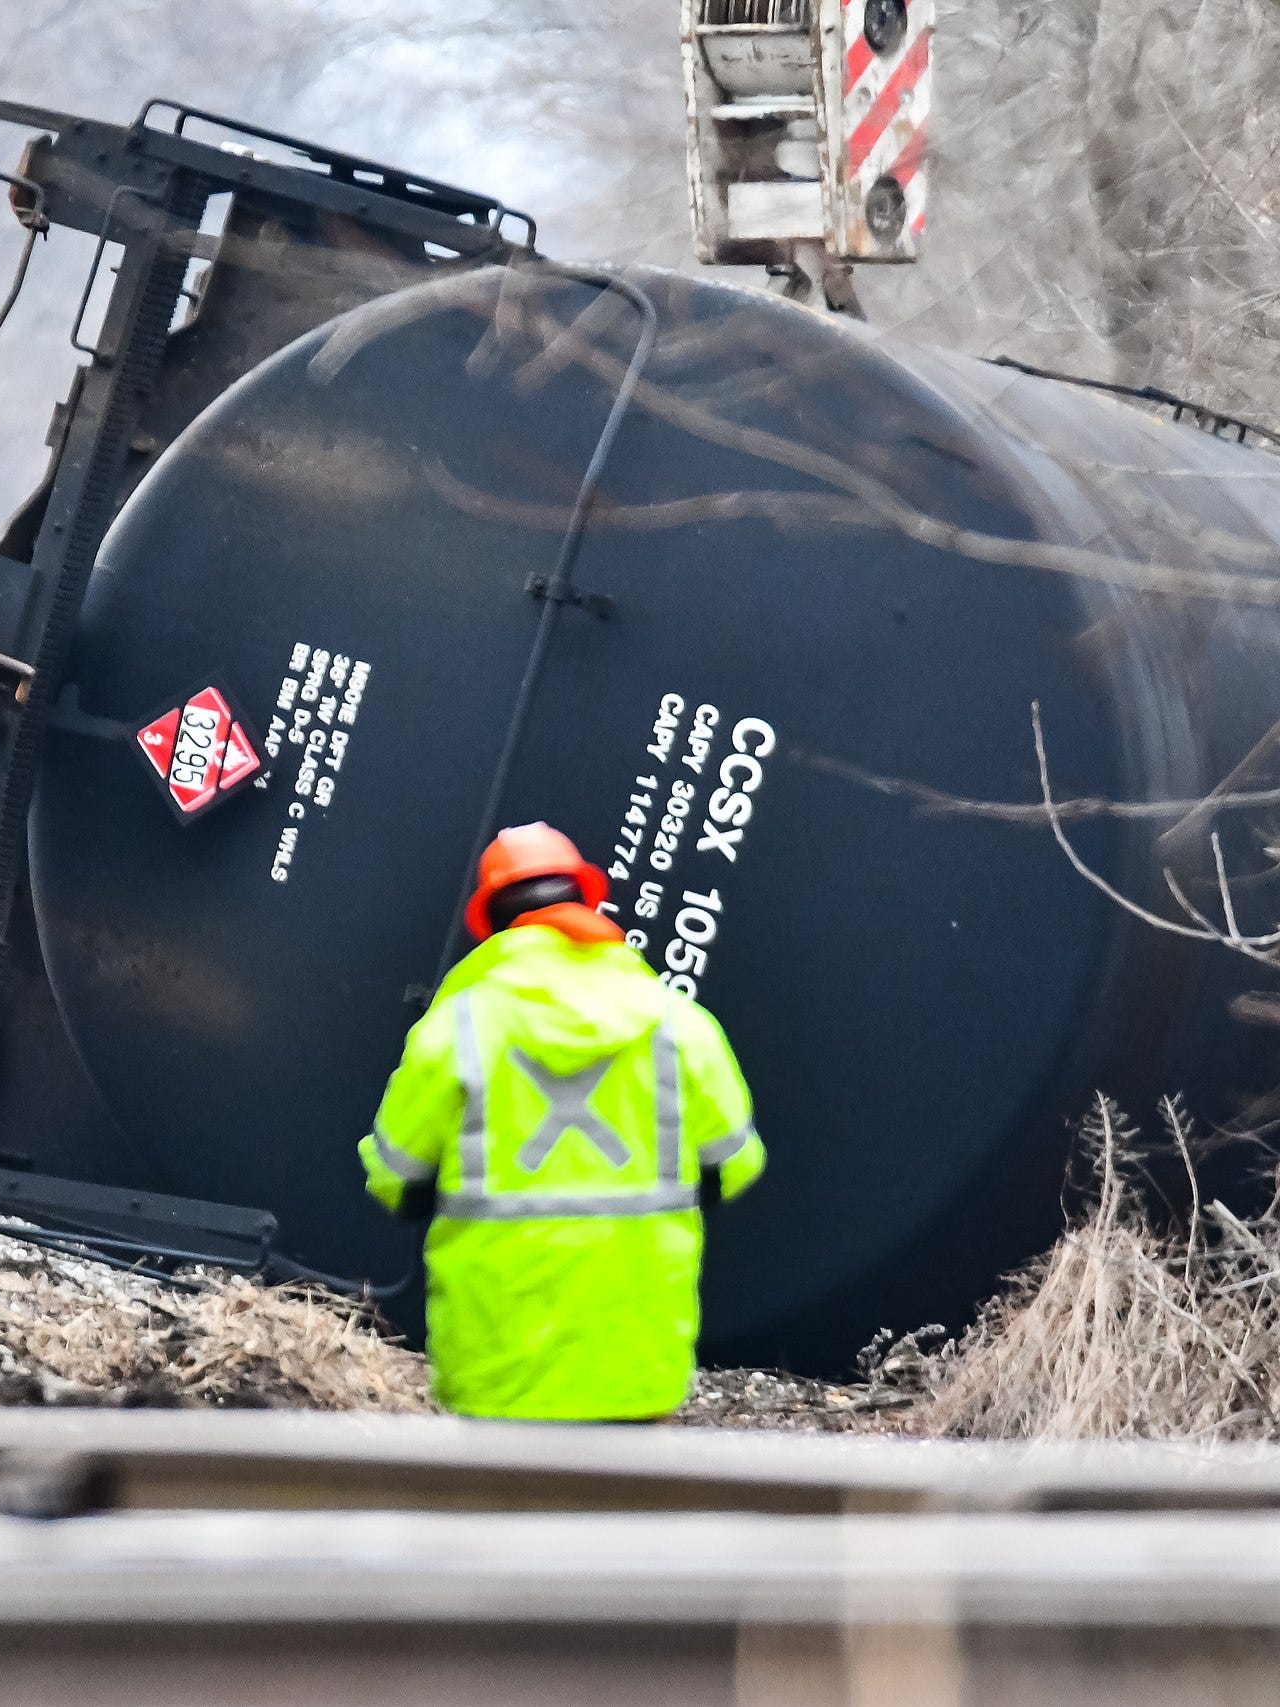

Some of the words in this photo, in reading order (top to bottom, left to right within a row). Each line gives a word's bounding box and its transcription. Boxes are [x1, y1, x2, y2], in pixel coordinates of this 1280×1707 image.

[289, 642, 311, 672] BR
[301, 648, 330, 701] SPRG
[276, 677, 300, 710] BM
[143, 730, 162, 746] 3
[173, 712, 216, 786] 3295
[325, 729, 350, 772] DFT
[646, 692, 685, 764] CAPY
[681, 703, 720, 775] CAPY
[295, 729, 327, 797] CLASS
[696, 716, 776, 863] CCSX
[288, 802, 305, 820] C
[314, 776, 335, 807] GR
[607, 774, 659, 881] 114774
[649, 779, 695, 872] 30320
[271, 827, 299, 883] WHLS
[634, 880, 664, 920] US
